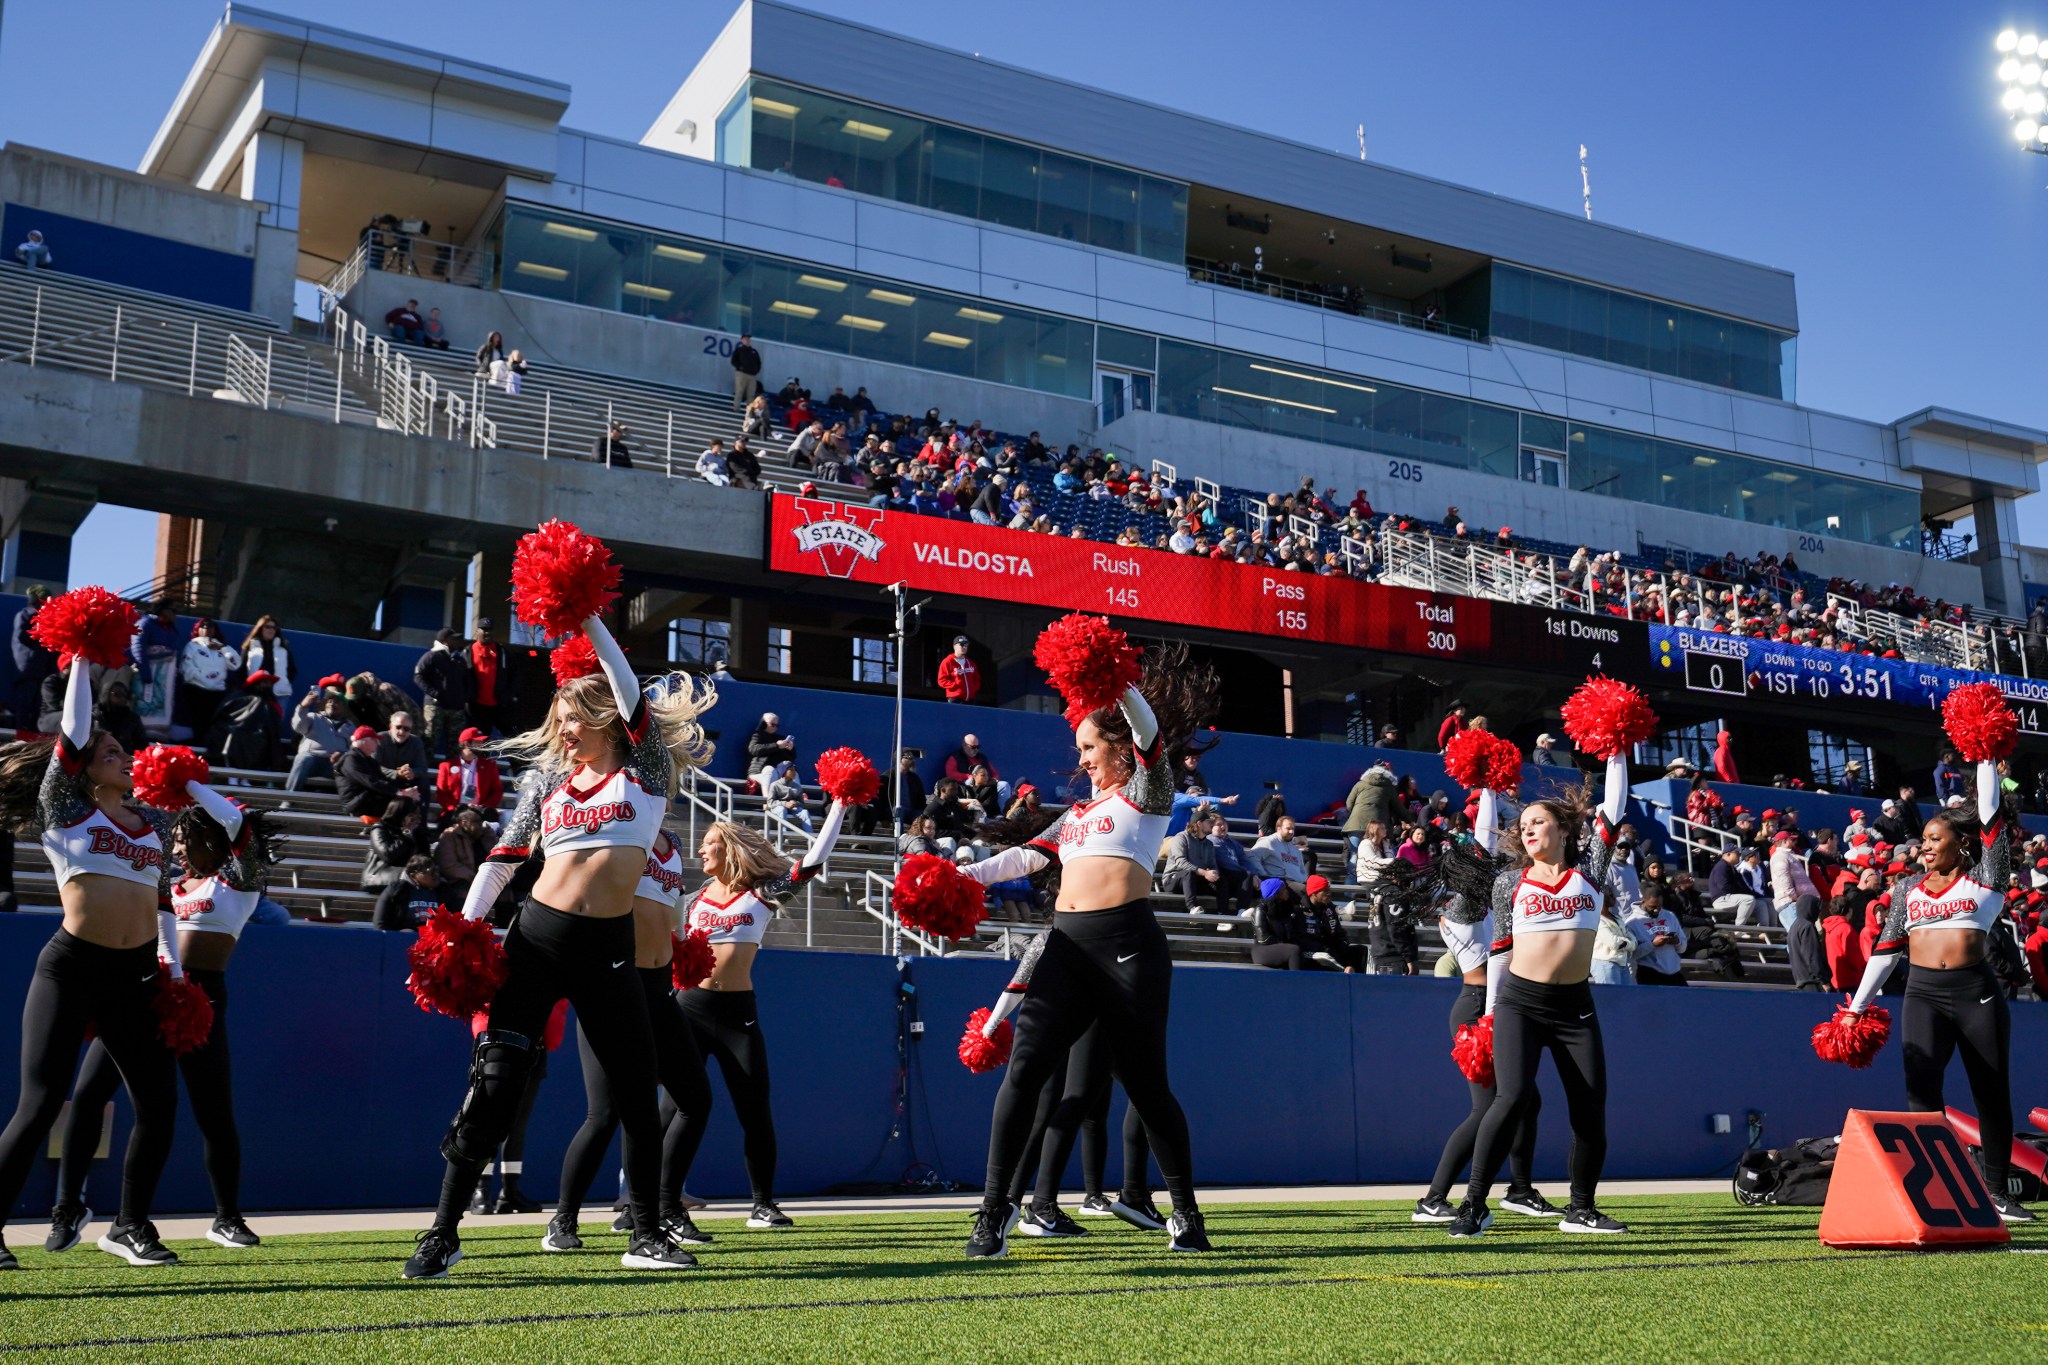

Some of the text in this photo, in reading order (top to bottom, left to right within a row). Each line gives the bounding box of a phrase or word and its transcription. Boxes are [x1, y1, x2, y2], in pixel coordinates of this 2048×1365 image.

[703, 335, 742, 358] 20
[1389, 460, 1423, 482] 205
[811, 526, 867, 548] STATE
[1799, 536, 1825, 554] 204
[913, 542, 1034, 577] VALDOSTA
[1093, 552, 1141, 577] Rush
[1105, 587, 1139, 608] 145
[1263, 577, 1305, 600] Pass
[1276, 610, 1307, 630] 155
[1416, 602, 1454, 624] Total
[1545, 617, 1619, 643] 1st Downs
[1427, 632, 1457, 651] 300
[1678, 632, 1749, 658] BLAZERS
[1591, 653, 1602, 669] 4
[1764, 653, 1795, 667] DOWN
[1802, 658, 1832, 672] TO GO
[1709, 664, 1724, 690] 0
[1764, 672, 1799, 695] 1ST
[1808, 676, 1829, 698] 10
[1839, 665, 1892, 700] 3:51
[1919, 674, 1939, 687] QTR
[1928, 692, 1936, 711] 1
[2017, 706, 2039, 731] 14
[541, 801, 636, 837] Blazers
[1519, 892, 1595, 919] Blazers
[1908, 898, 1978, 922] Blazers
[697, 911, 754, 932] Blazers
[1873, 1123, 2000, 1228] 20
